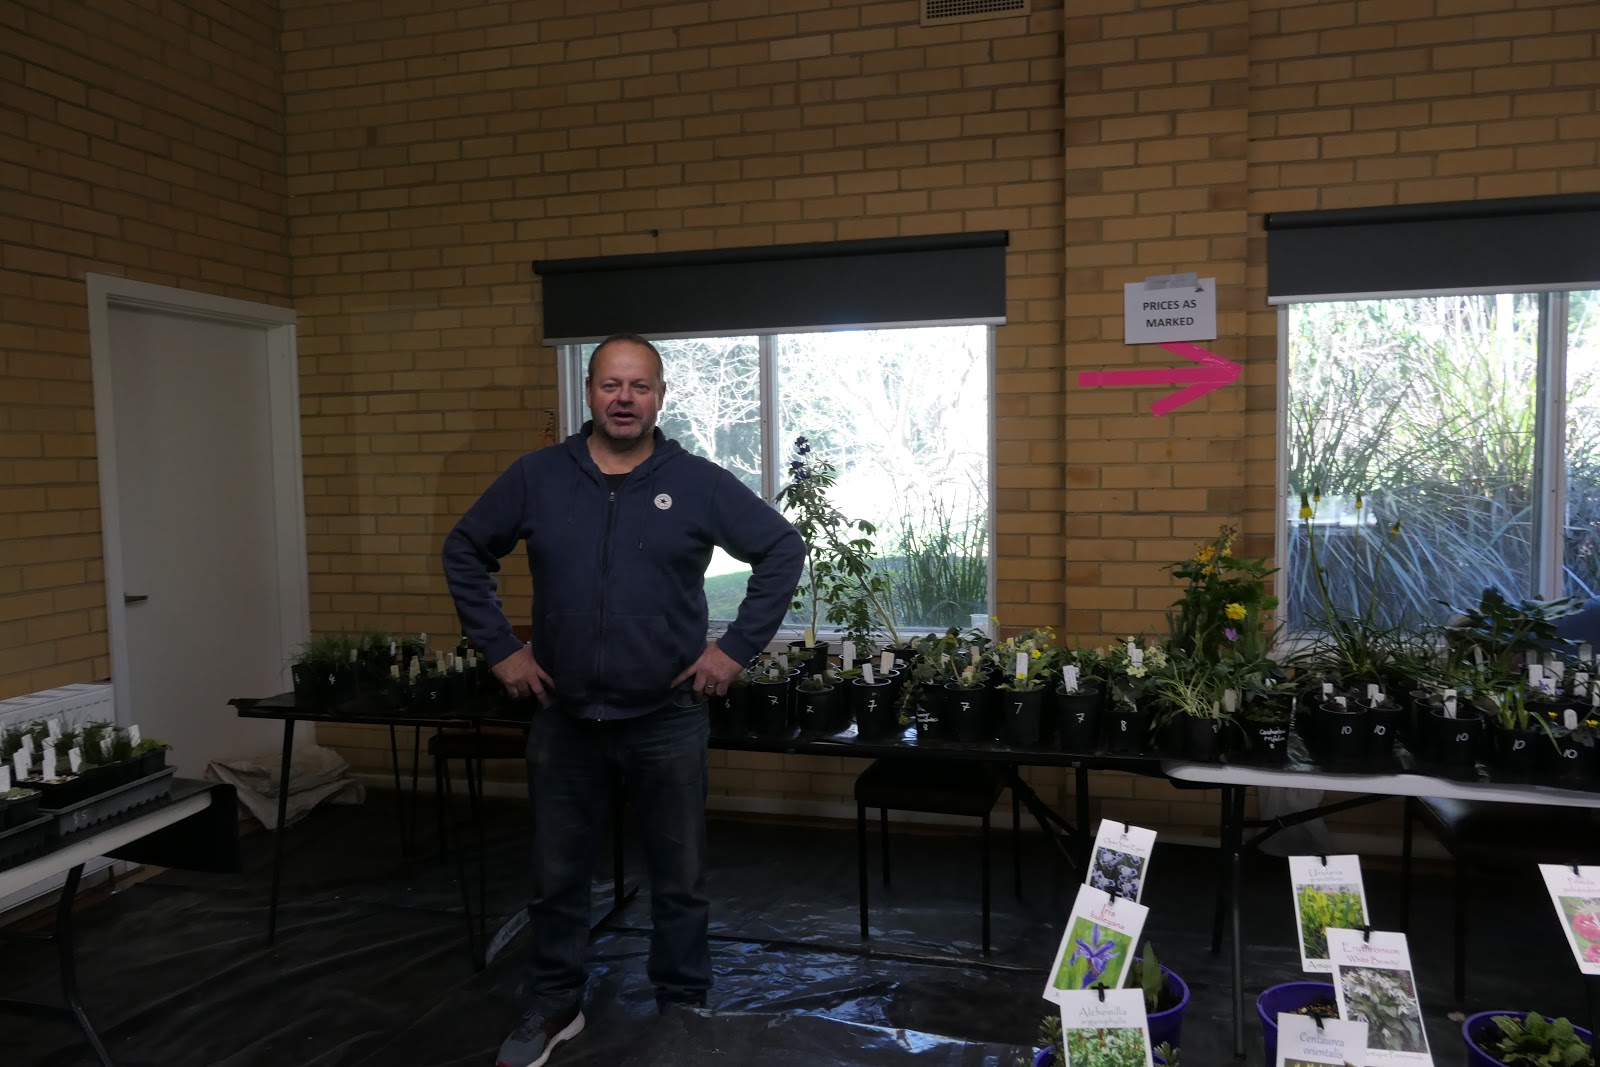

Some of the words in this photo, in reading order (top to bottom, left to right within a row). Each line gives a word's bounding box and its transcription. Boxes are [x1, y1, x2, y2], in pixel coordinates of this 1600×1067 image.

[1143, 300, 1180, 311] PRICES
[1182, 299, 1197, 309] AS
[1146, 317, 1194, 328] MARKED
[328, 673, 336, 686] 4
[725, 698, 731, 709] 6
[768, 695, 779, 706] 7
[867, 699, 878, 713] 7
[960, 701, 970, 712] 7
[806, 705, 814, 713] 7
[1014, 702, 1023, 715] 7
[1076, 713, 1085, 724] 7
[1120, 719, 1127, 732] 8
[1341, 725, 1353, 735] 10
[1373, 724, 1387, 736] 10
[1456, 732, 1469, 742] 10
[1512, 738, 1526, 751] 10
[1563, 748, 1578, 759] 10
[1101, 903, 1116, 918] Iris
[1089, 910, 1125, 931] bulleyana
[1342, 941, 1400, 955] Erythronium
[1079, 1005, 1128, 1018] Alchemilla
[1299, 1032, 1345, 1047] Centaurea
[1303, 1047, 1344, 1059] orientalis
